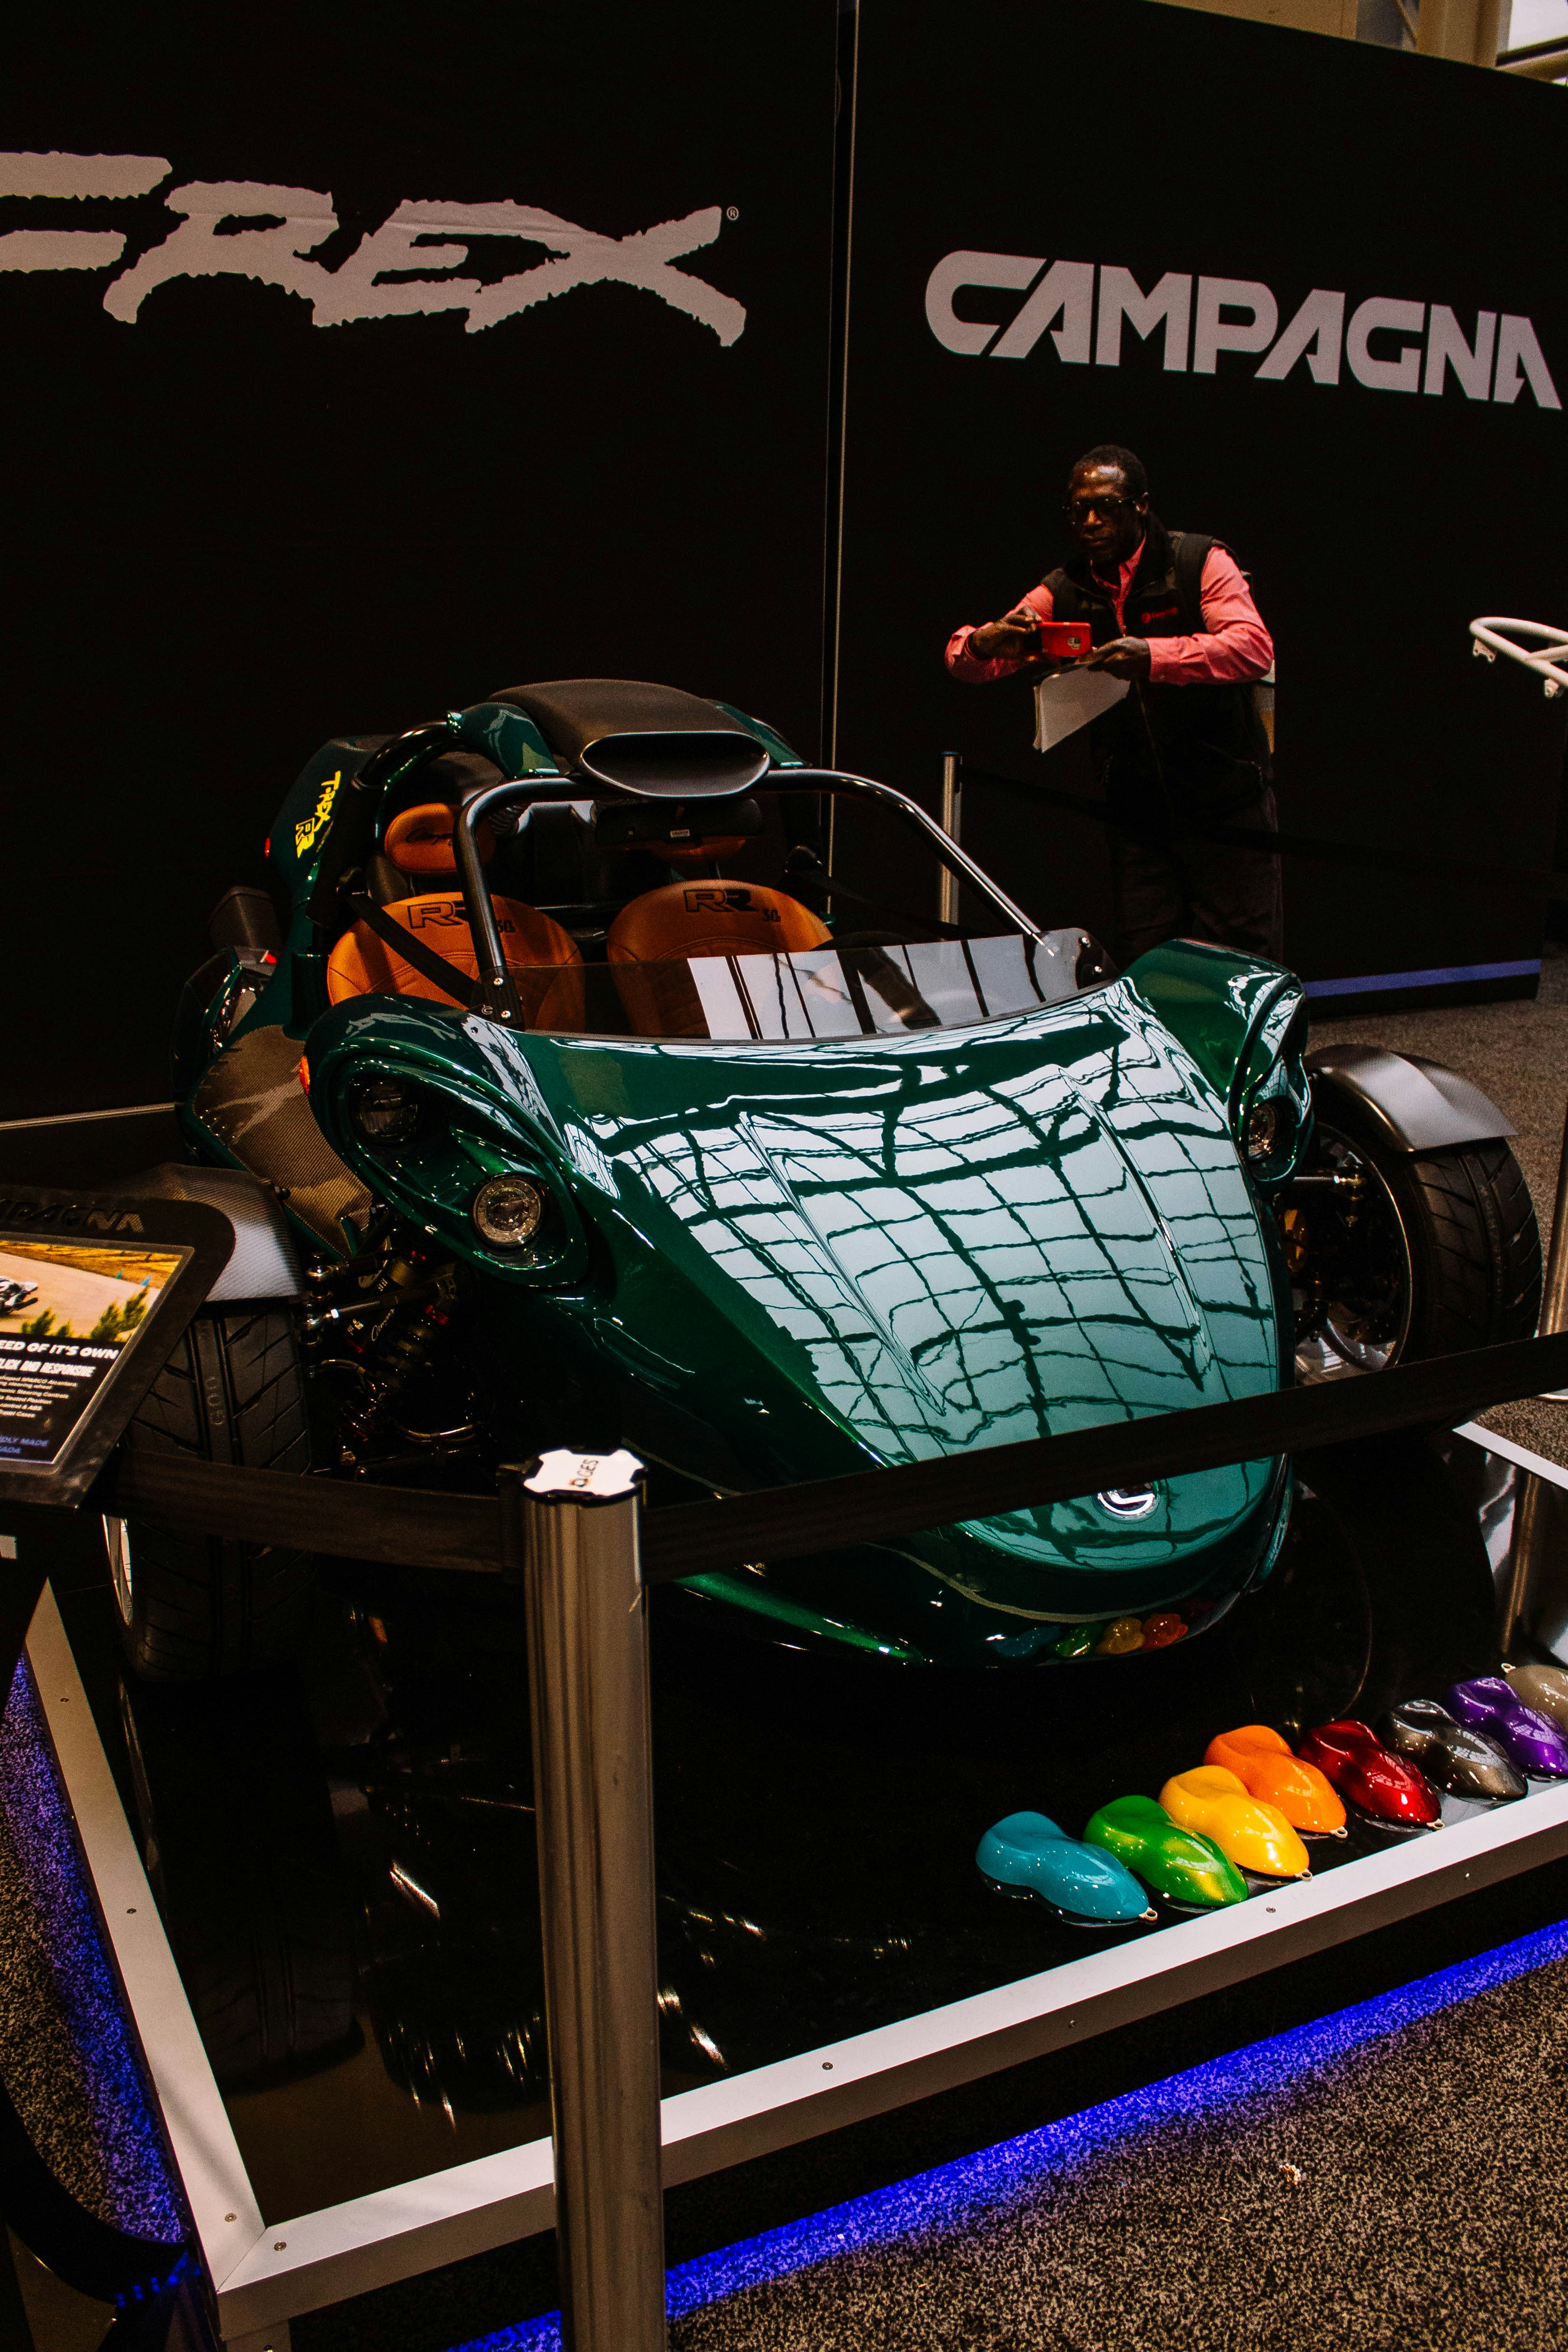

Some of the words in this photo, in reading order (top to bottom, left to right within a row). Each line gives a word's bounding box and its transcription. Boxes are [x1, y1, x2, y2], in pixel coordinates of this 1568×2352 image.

[925, 249, 1563, 410] CAMPAGNA
[27, 1342, 50, 1352] OF
[49, 1344, 79, 1356] IT'S
[80, 1348, 119, 1359] OWN
[19, 1360, 42, 1372] AND
[39, 1362, 96, 1377] RESPONSIVE
